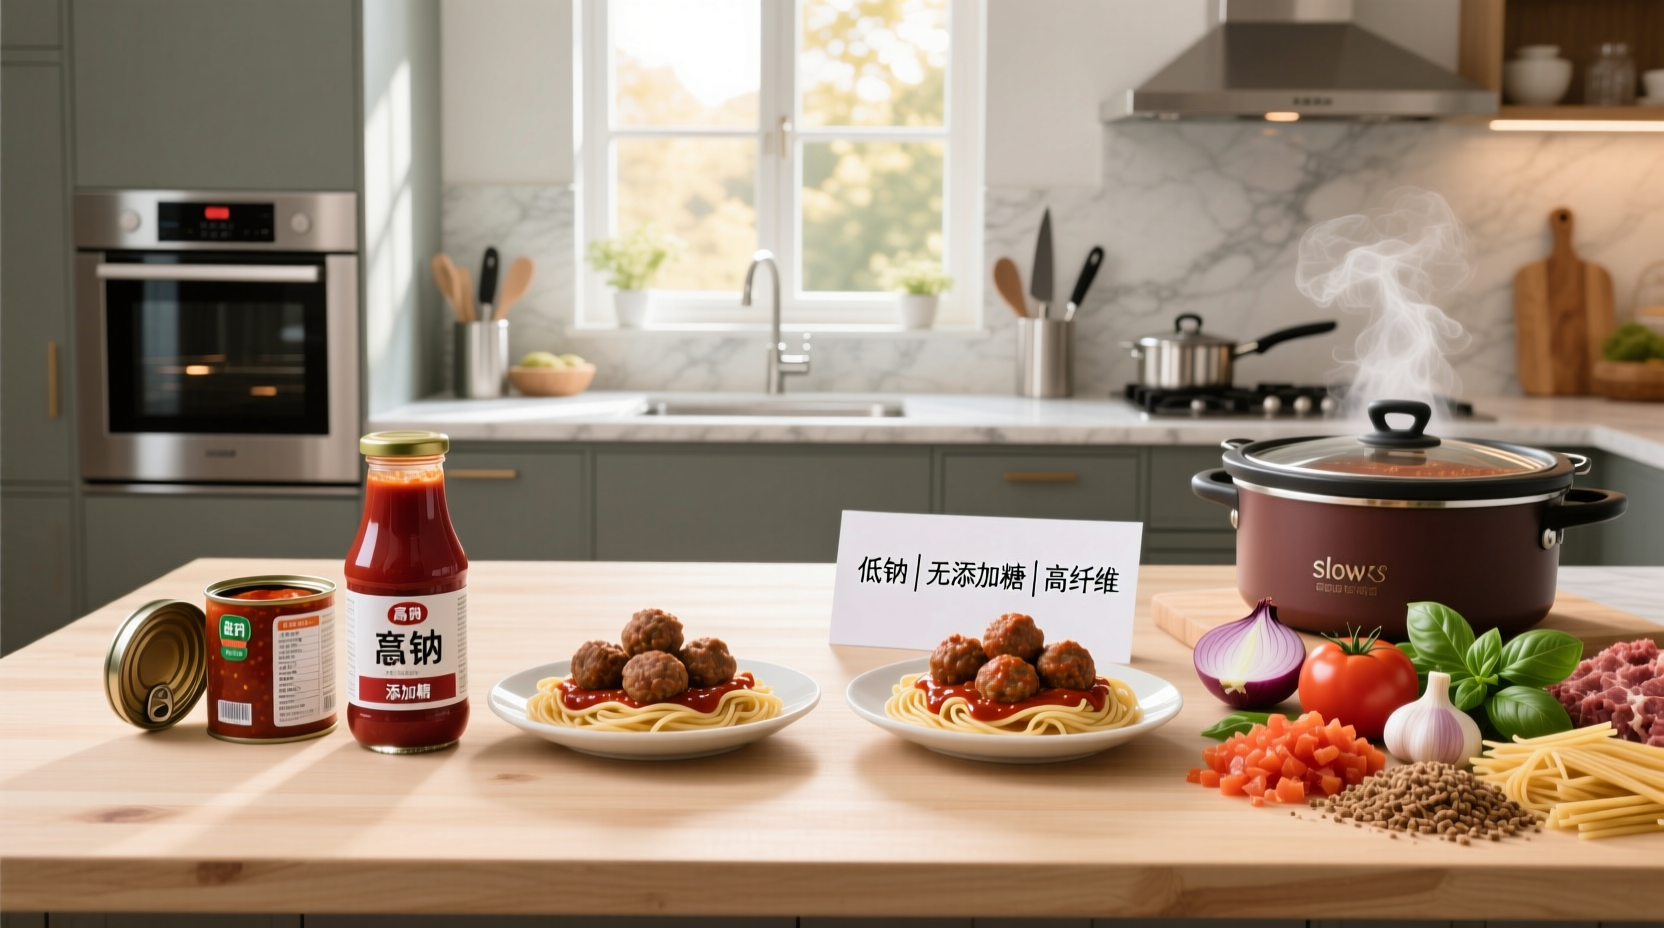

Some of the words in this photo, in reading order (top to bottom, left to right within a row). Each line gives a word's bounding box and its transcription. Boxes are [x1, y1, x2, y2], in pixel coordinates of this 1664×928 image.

[857, 555, 908, 585] 低钠
[926, 560, 1027, 591] 无添加糖
[1044, 563, 1120, 595] 高纤维
[376, 628, 442, 666] 高钠
